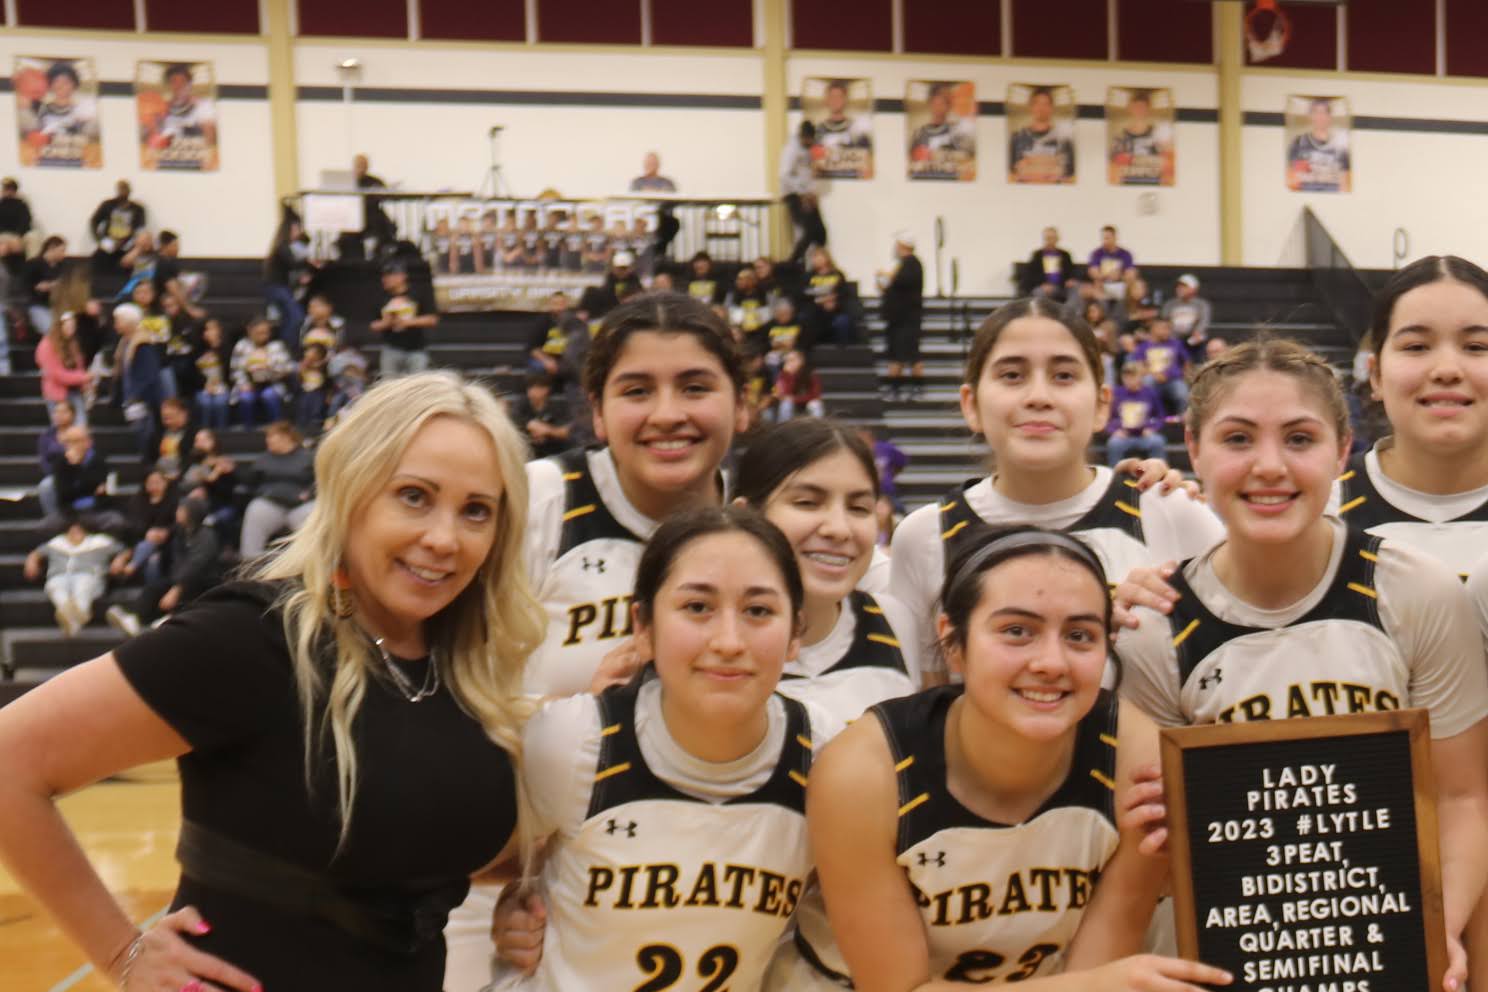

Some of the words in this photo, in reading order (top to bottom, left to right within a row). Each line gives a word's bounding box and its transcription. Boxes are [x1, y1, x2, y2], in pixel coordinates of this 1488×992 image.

[1262, 764, 1337, 789] LADY
[1247, 783, 1358, 812] PIRATES
[1207, 817, 1275, 843] 2023
[1296, 808, 1391, 835] #LYTLE
[1265, 841, 1349, 868] 3PEAT,
[583, 861, 803, 918] PIRATES
[1241, 866, 1386, 897] BIDISTRICT,
[1205, 906, 1280, 931] AREA,
[1282, 892, 1411, 923] REGIONAL
[1238, 925, 1354, 953] QUARTER
[1366, 922, 1385, 944] &
[1242, 950, 1384, 983] SEMIFINAL
